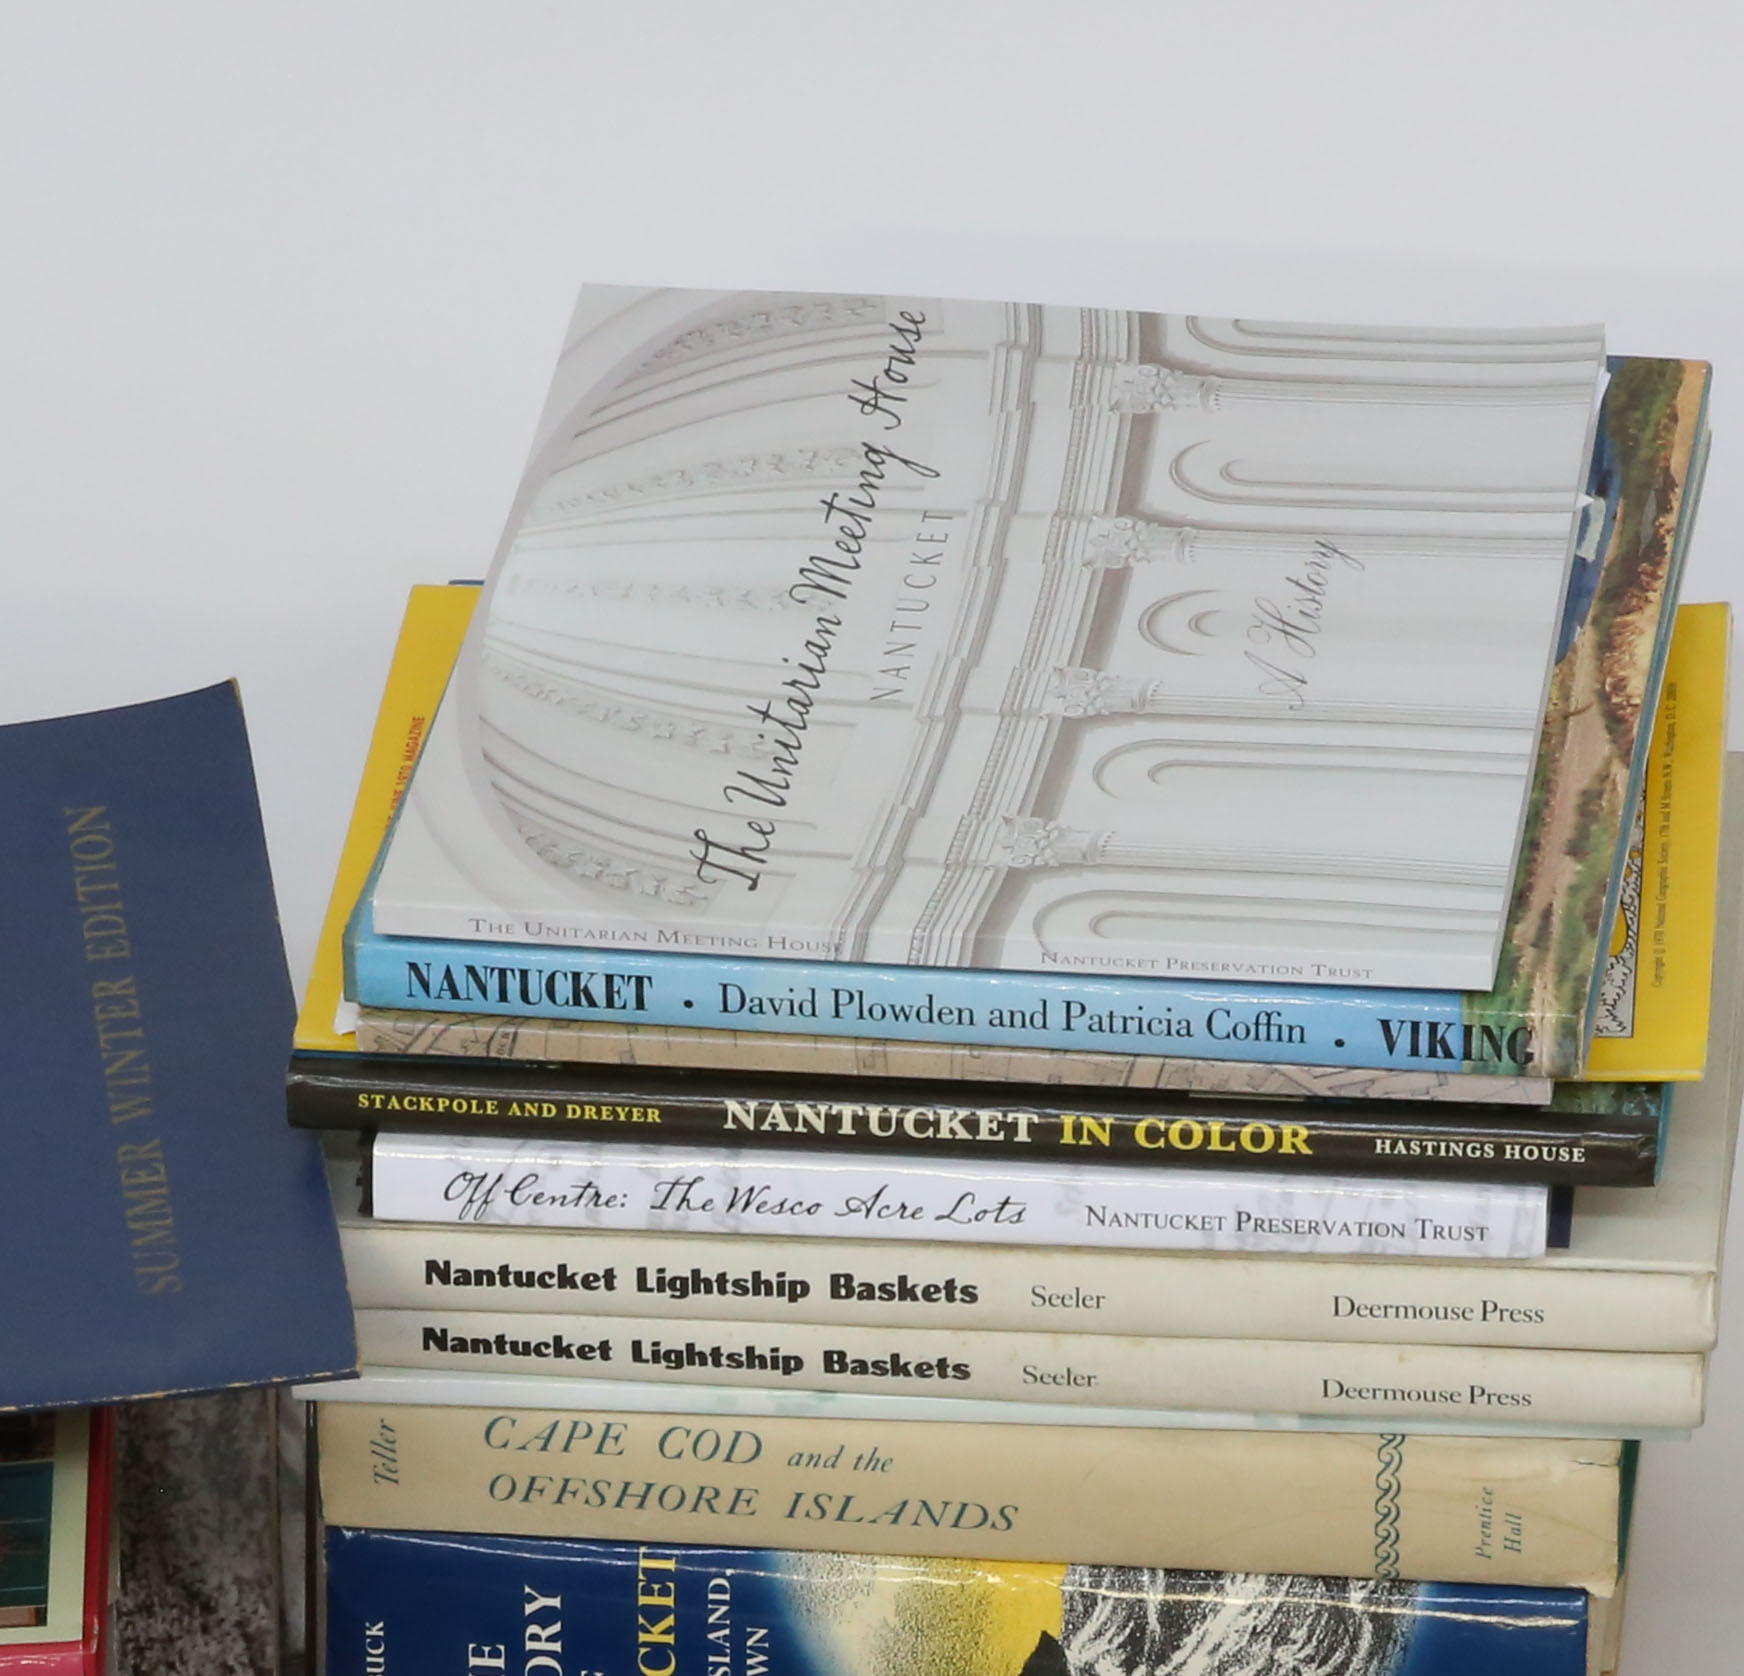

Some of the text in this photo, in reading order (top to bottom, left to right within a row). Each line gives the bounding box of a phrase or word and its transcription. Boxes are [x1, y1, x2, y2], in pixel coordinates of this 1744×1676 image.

[689, 308, 941, 891] The Unitarian Meeting House
[870, 510, 954, 701] NANTUCKET
[1248, 536, 1366, 660] History
[406, 961, 1536, 1066] NANTUCKET David Plowden and Patricia Coffin VIKING
[64, 805, 184, 1297] SUMMER WINTER EDITION
[357, 1093, 1586, 1164] STACKPOLE AND DREYER NANTUCKET IN COLOR HASTINGS HOUSE
[442, 1169, 1028, 1227] Off Centre: The Wesco Acre Lots
[424, 1259, 1546, 1325] Nantucket Lightship Baskets Seeler Deermouse Press
[421, 1327, 1533, 1408] Nantucket Lightship Baskets Seeler Deermouse Press
[373, 1417, 401, 1489] Teller
[483, 1414, 896, 1475] CAPE COD and the
[486, 1472, 1022, 1534] OFFSHORE ISLANDS
[1503, 1511, 1523, 1555] Hall
